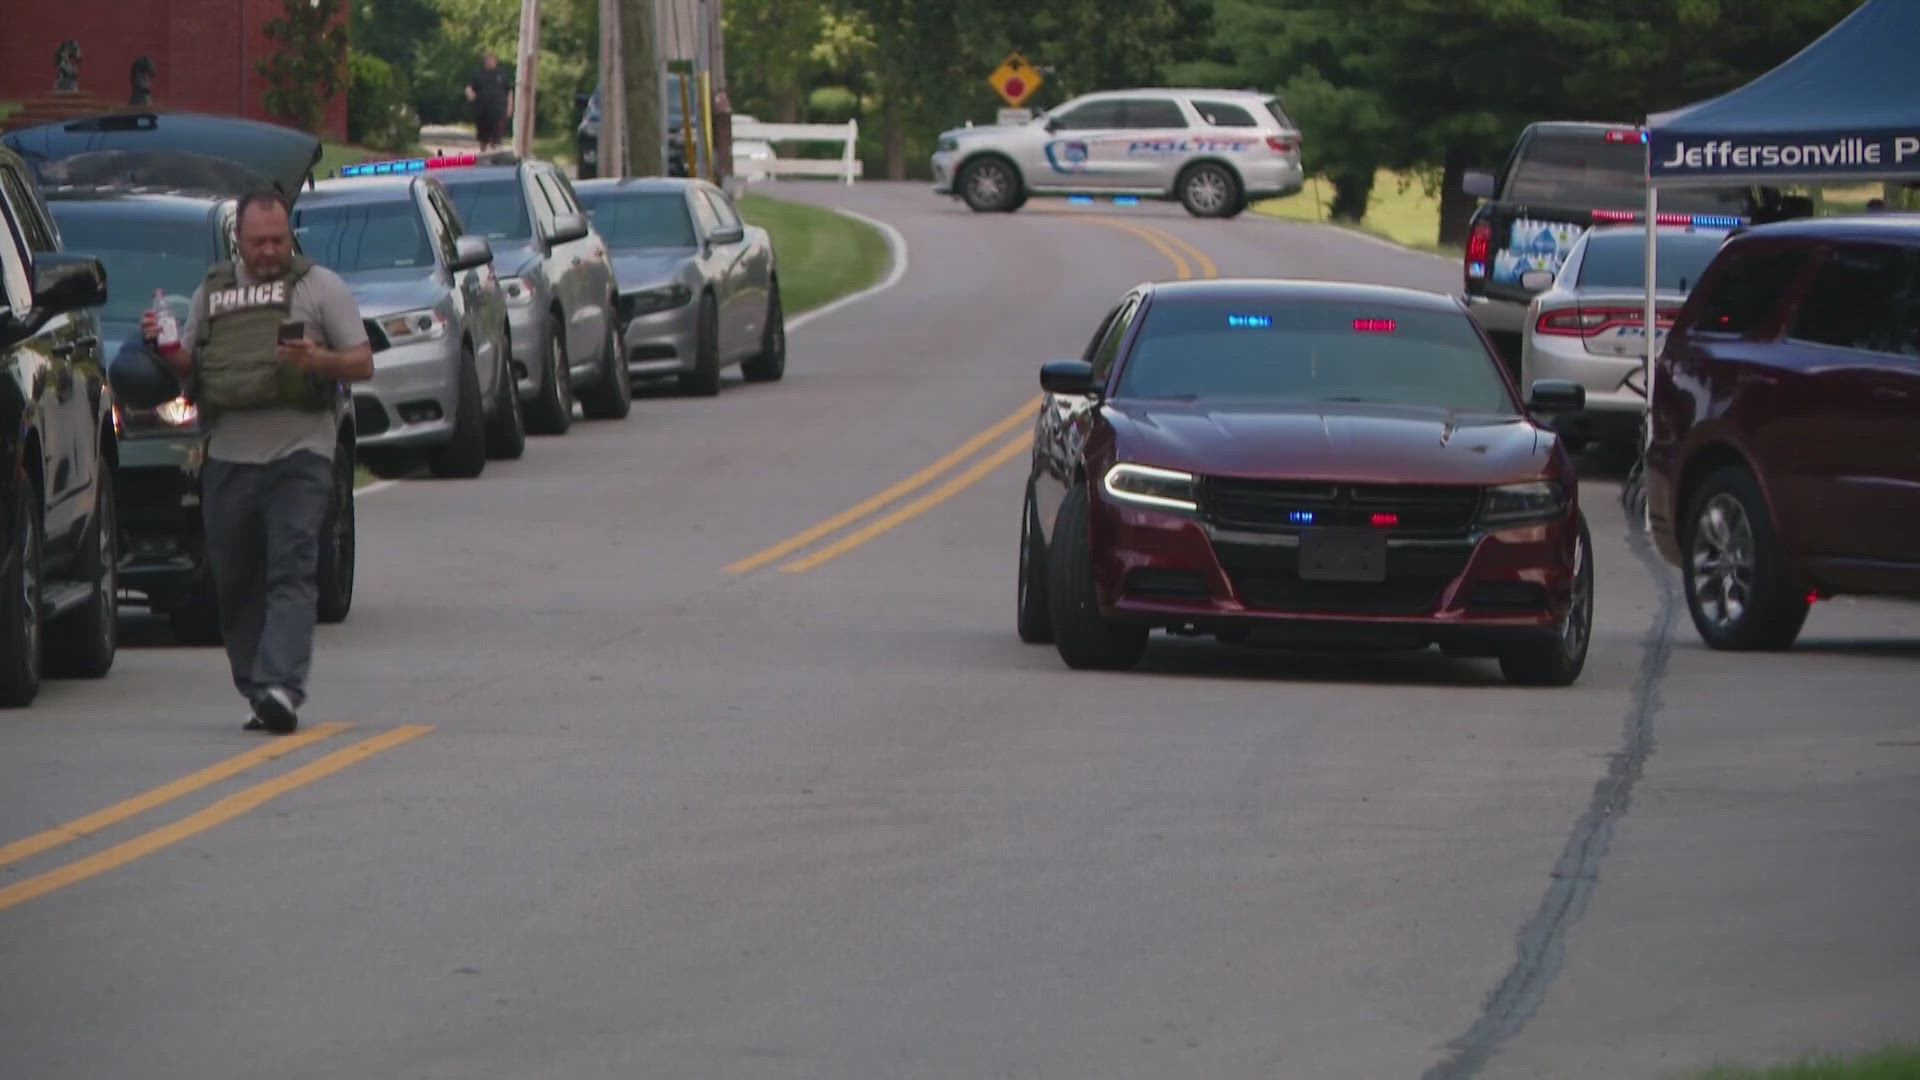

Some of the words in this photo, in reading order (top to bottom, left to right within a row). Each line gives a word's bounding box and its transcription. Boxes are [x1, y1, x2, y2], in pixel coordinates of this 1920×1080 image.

[1128, 140, 1248, 153] POLICE
[1663, 138, 1881, 168] Jeffersonville
[209, 281, 285, 316] POLICE
